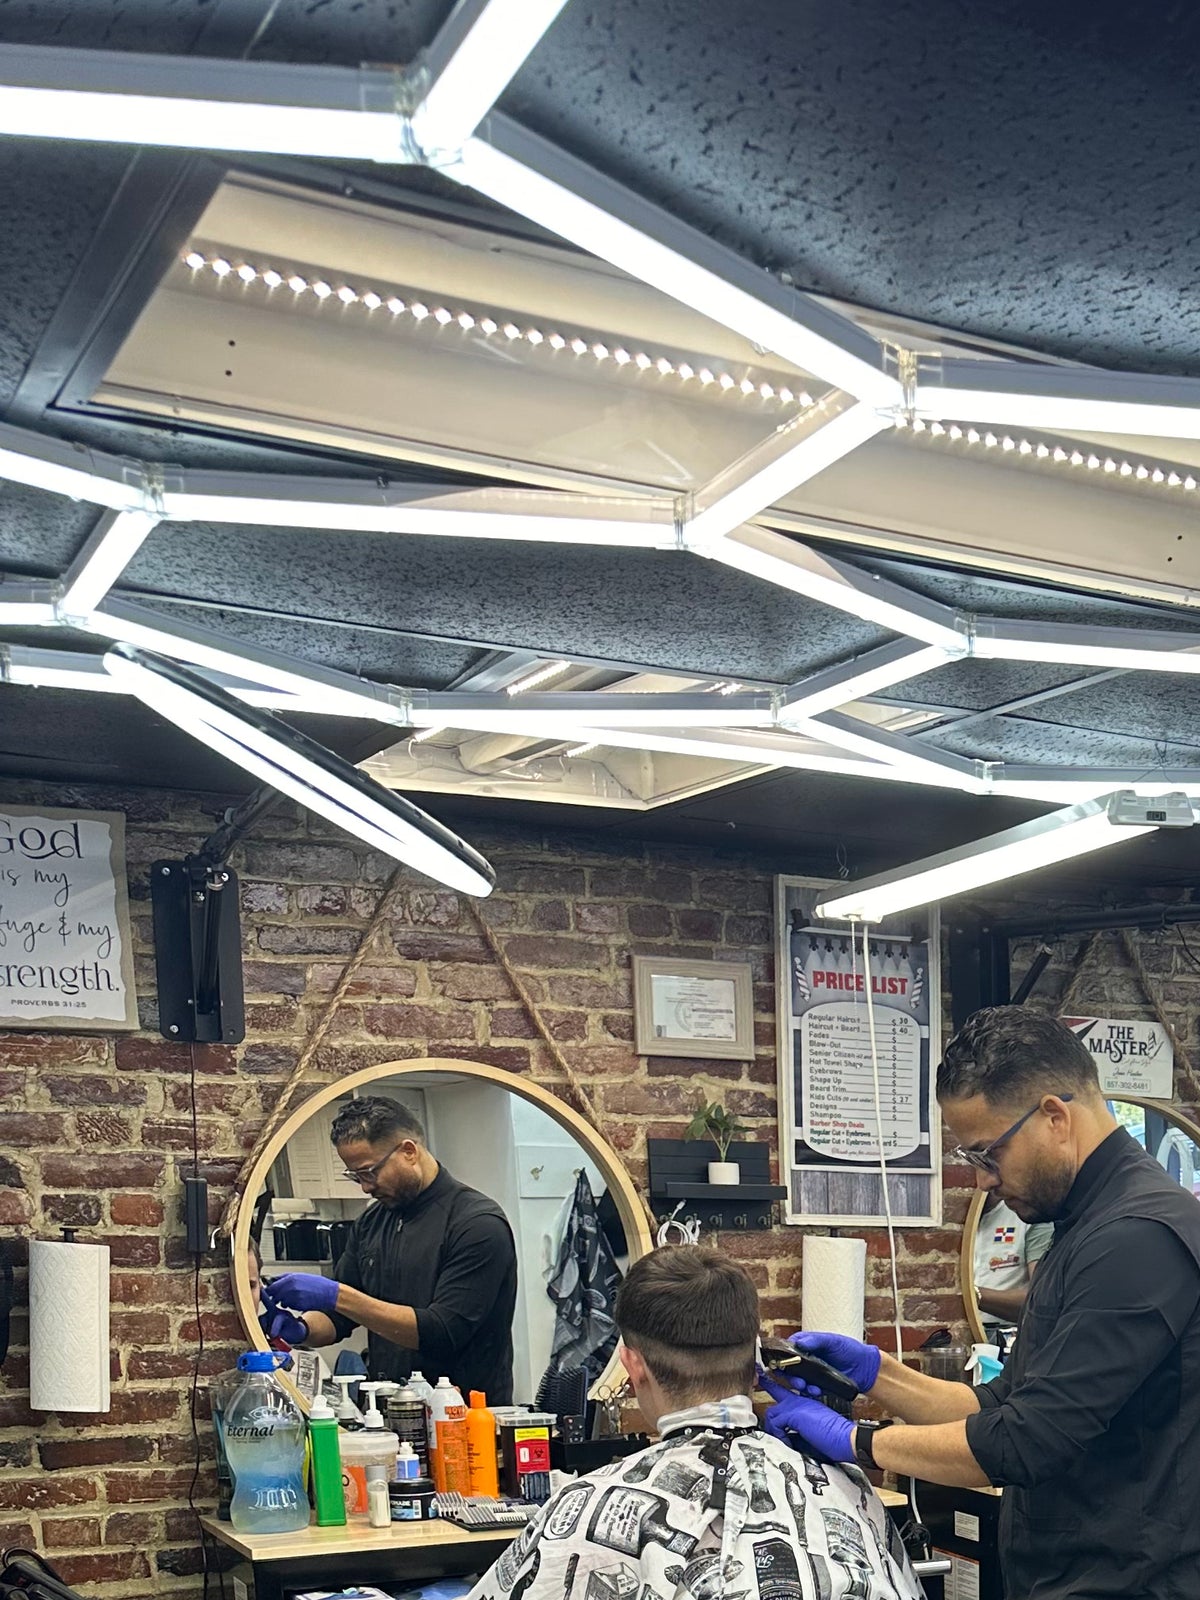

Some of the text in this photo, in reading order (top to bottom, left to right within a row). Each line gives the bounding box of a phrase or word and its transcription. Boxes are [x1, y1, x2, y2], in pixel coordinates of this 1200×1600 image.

[2, 869, 72, 907] is my
[59, 911, 71, 946] &
[78, 922, 115, 959] my
[812, 970, 908, 995] PRICE LIST
[11, 999, 60, 1007] PROVERBS
[1108, 1025, 1134, 1040] THE
[1089, 1038, 1149, 1063] MASTER
[227, 1425, 275, 1437] Eternal
